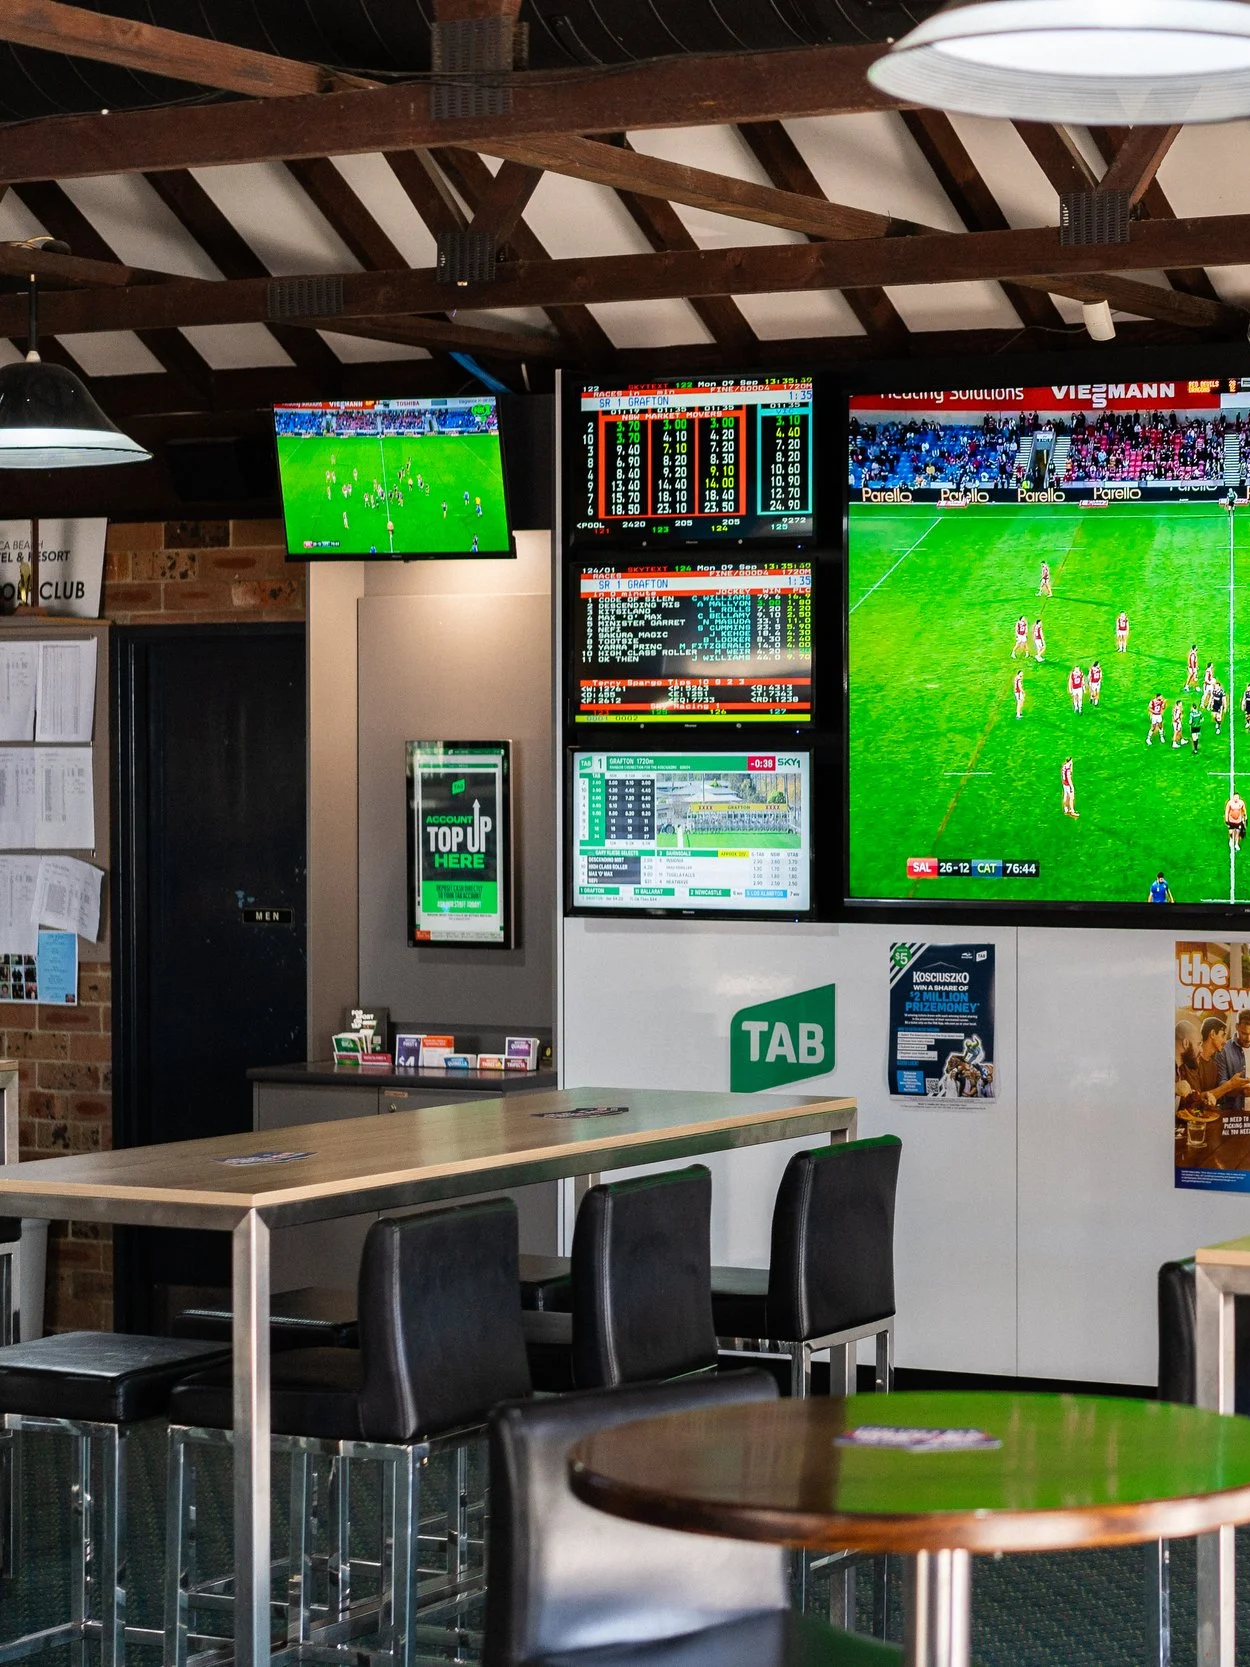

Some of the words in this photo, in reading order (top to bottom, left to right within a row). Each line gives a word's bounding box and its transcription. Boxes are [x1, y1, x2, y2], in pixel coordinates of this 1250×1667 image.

[600, 398, 610, 407] SR
[617, 398, 621, 406] 1
[629, 397, 668, 406] GRAFTON
[789, 391, 812, 400] 1:35
[862, 488, 912, 503] Parello
[1017, 489, 1066, 503] Parello
[1093, 487, 1141, 499] Parello
[13, 540, 43, 550] BEAH
[17, 552, 24, 563] &
[599, 580, 610, 589] SR
[617, 580, 621, 588] 1
[628, 579, 668, 589] GRAFTON
[789, 576, 811, 585] 1:35
[40, 582, 85, 600] CLUB
[598, 758, 602, 768] 1
[426, 816, 473, 824] ACCOUNT
[427, 826, 463, 852] TOP
[467, 816, 492, 852] UP
[434, 853, 484, 868] HERE
[913, 862, 931, 872] SAL
[940, 863, 969, 873] 26-12
[977, 865, 996, 873] CAT
[1006, 864, 1036, 874] 76:44
[256, 912, 279, 920] MEN
[895, 952, 908, 965] $5
[1180, 953, 1227, 985] the
[913, 972, 969, 983] KOSCIUSZKO
[910, 992, 920, 1001] $2
[923, 992, 968, 1002] MILLION
[742, 1020, 824, 1064] TAB
